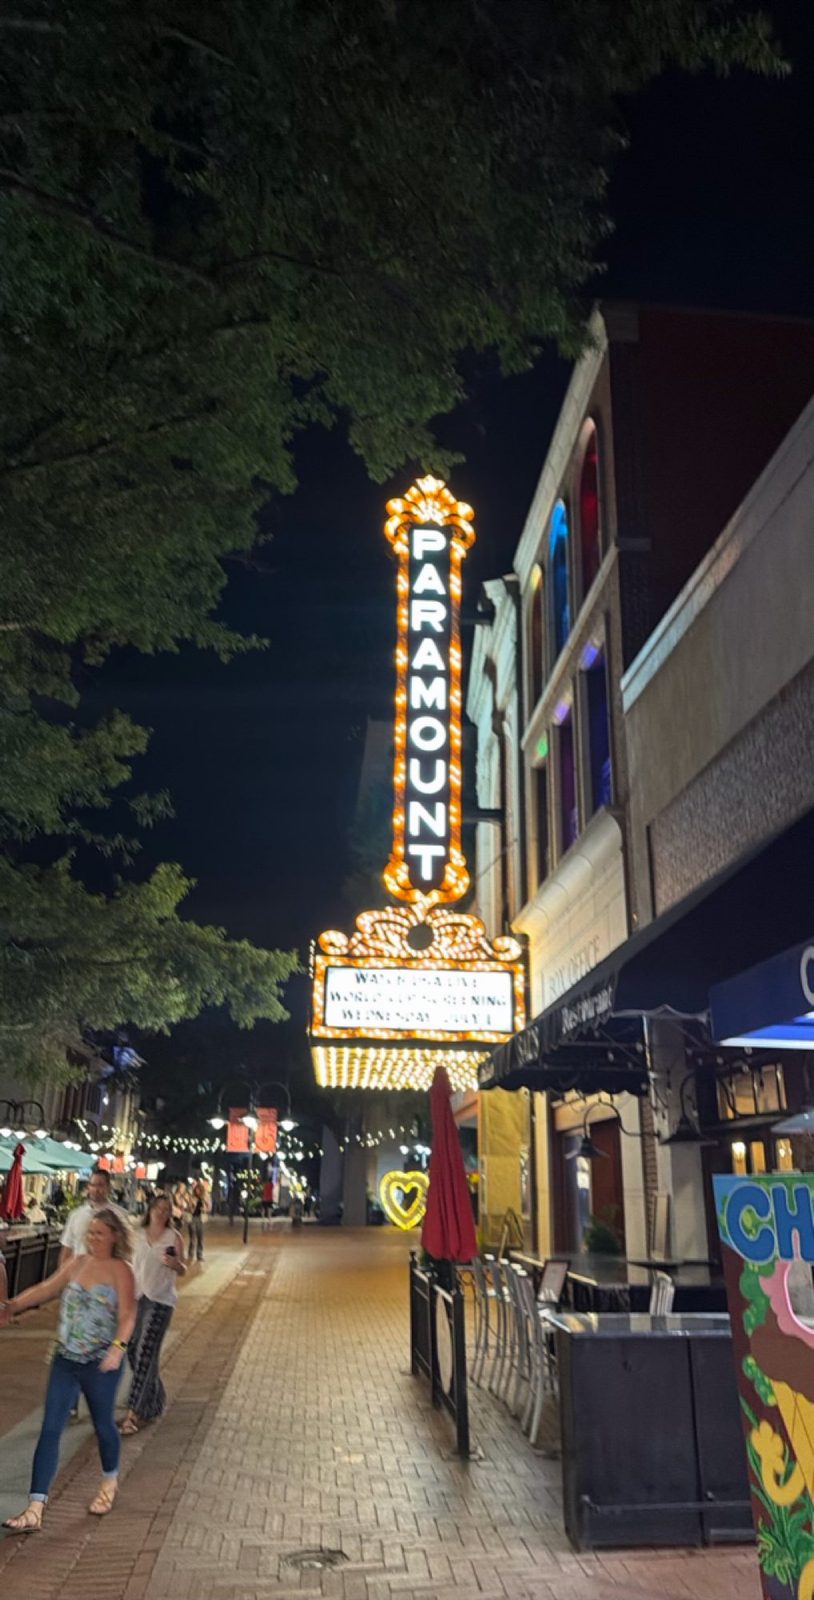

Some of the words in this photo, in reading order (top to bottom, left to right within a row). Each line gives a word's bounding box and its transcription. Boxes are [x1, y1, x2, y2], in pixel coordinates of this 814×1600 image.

[408, 528, 447, 882] PARAMOUNT
[354, 972, 407, 986] WAH
[411, 975, 442, 987] SA
[329, 991, 383, 1004] WRL
[421, 993, 507, 1007] SEENING
[443, 1012, 480, 1025] ULY
